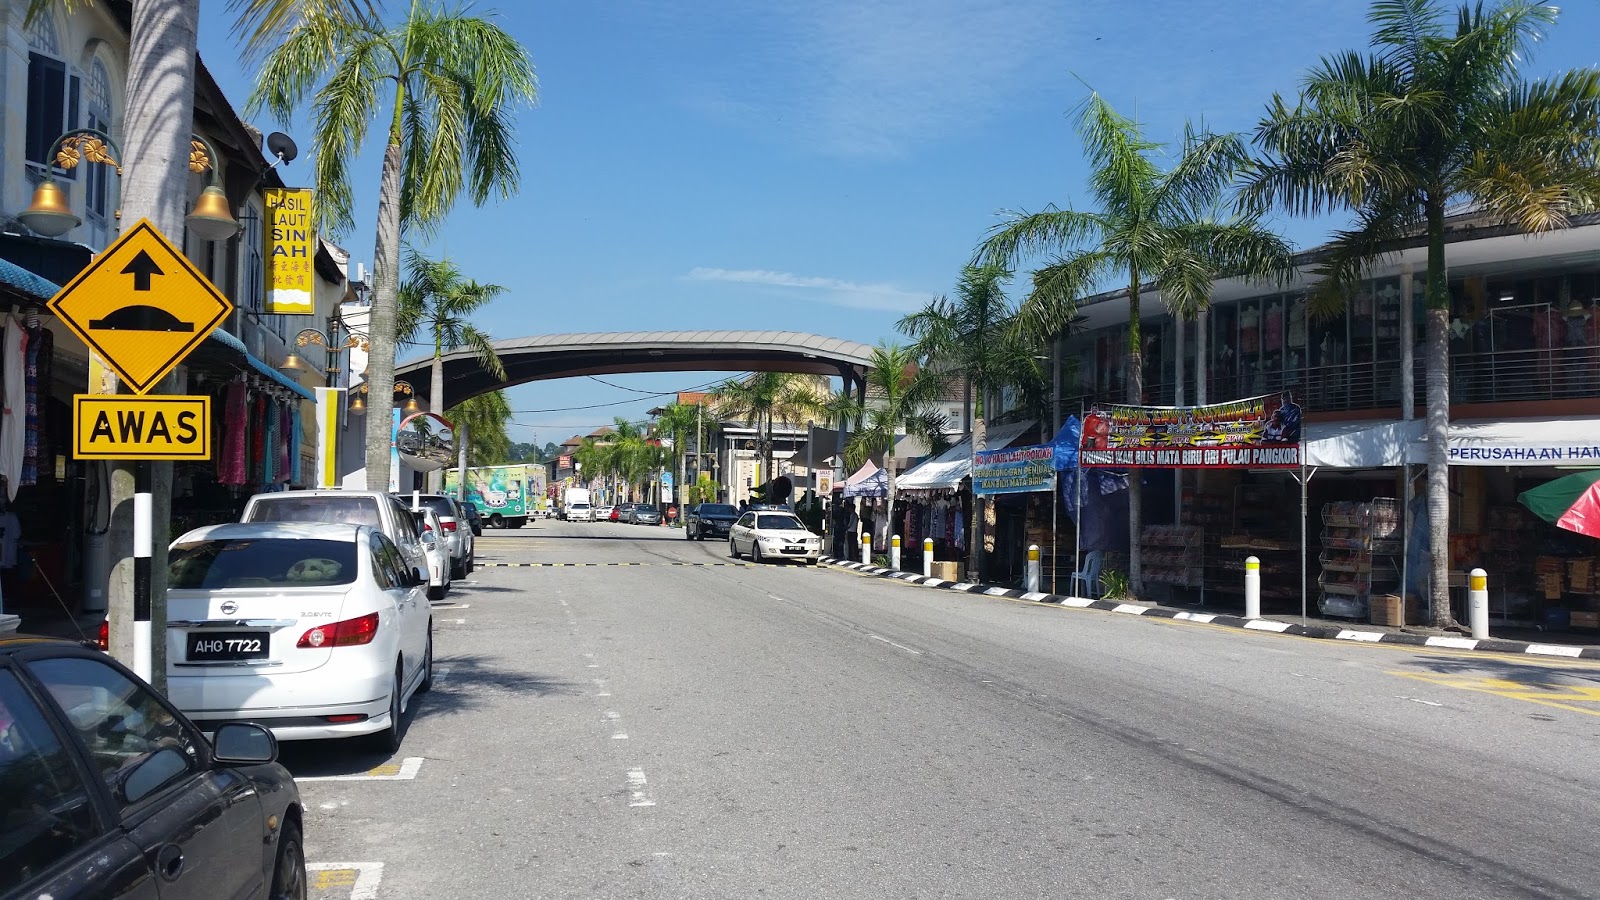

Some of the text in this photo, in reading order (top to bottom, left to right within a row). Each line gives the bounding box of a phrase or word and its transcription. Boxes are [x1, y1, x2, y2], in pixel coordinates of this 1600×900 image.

[270, 198, 306, 211] HASIL
[270, 213, 306, 226] LAUT
[270, 228, 306, 242] SIN
[271, 244, 307, 258] AH
[89, 410, 198, 445] AWAS
[1226, 426, 1252, 434] Barang
[1156, 450, 1180, 464] MATA
[1182, 450, 1202, 464] BIRU
[1204, 449, 1219, 464] ORI
[1221, 449, 1251, 464] PULAU
[1252, 447, 1298, 464] PANGKOR
[1450, 446, 1562, 460] PERUSAHAAN
[225, 639, 262, 653] 7722
